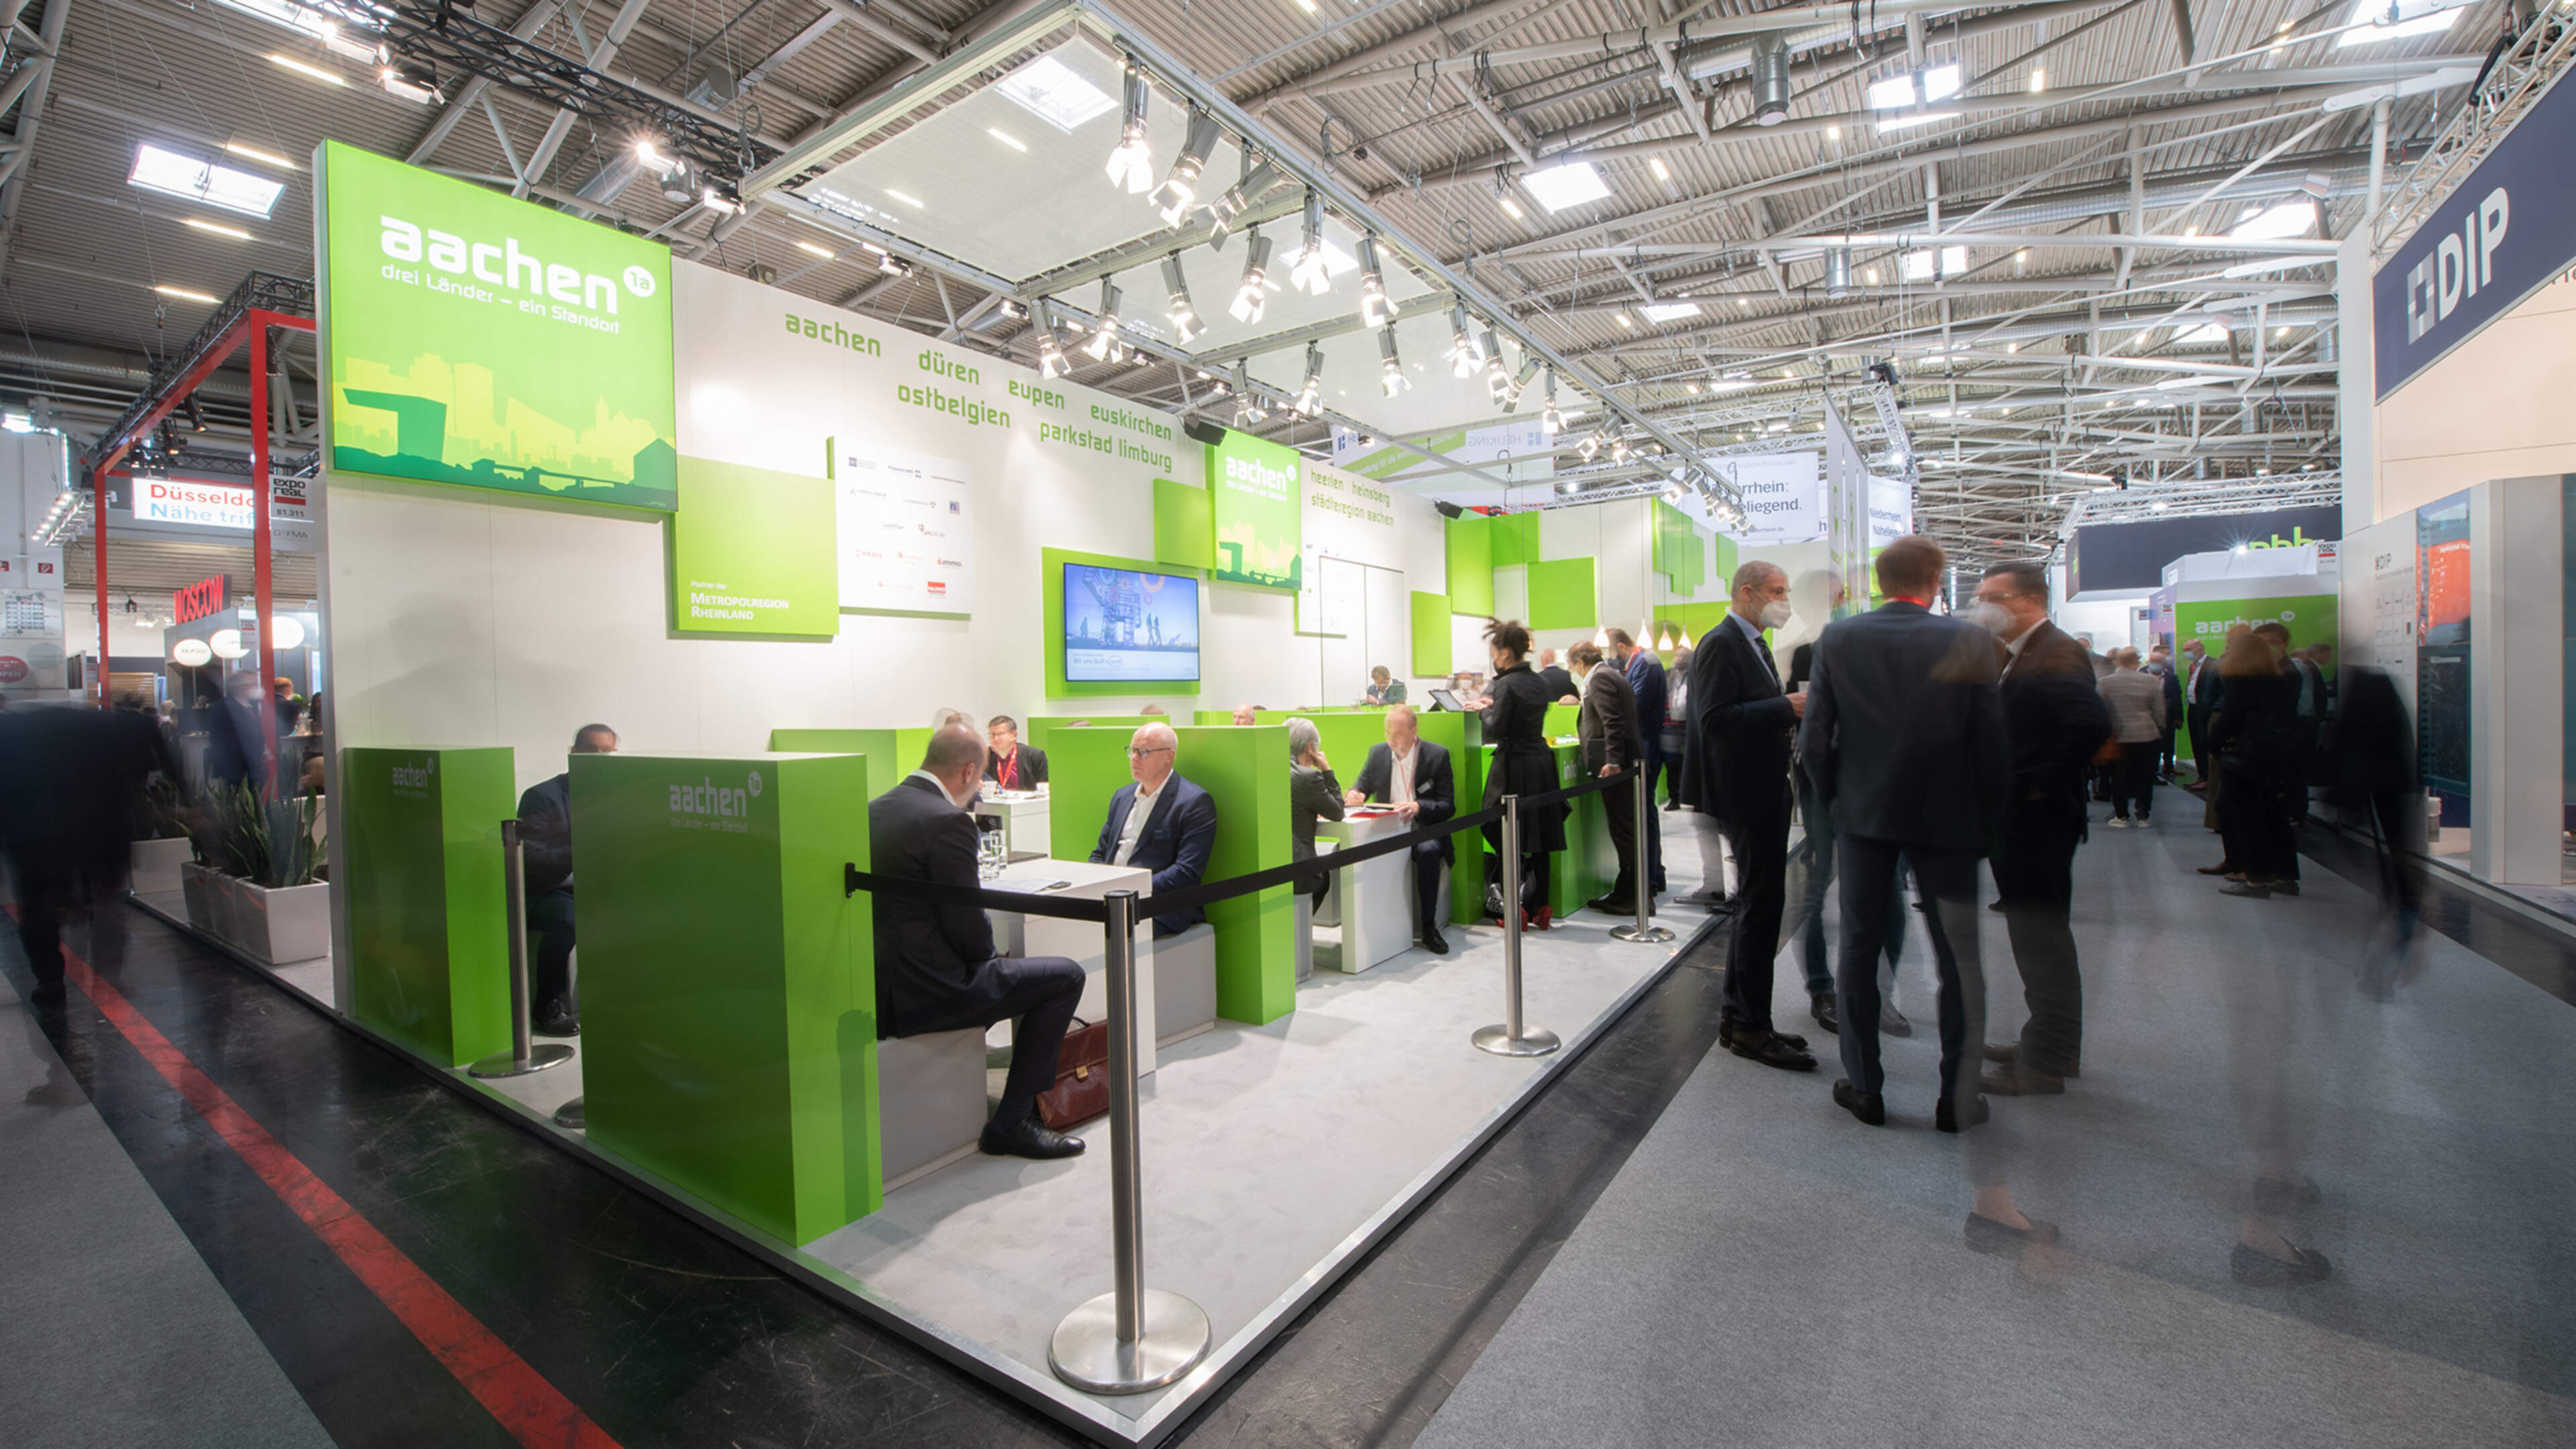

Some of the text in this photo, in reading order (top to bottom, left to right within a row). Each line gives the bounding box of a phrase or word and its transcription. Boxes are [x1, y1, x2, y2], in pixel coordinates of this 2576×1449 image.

[381, 215, 618, 315] aachen
[2437, 186, 2510, 321] DIP
[381, 264, 419, 286] drei
[427, 273, 493, 304] Länder
[519, 299, 546, 317] ein
[551, 305, 619, 335] Standort
[785, 313, 1172, 441] aachen düren eupen euskirchen
[898, 384, 1172, 474] ostbelgien parkstad limburg
[273, 478, 306, 490] expo
[273, 486, 306, 497] real
[1226, 456, 1287, 492] aachen
[1310, 468, 1344, 491] heerlen
[1352, 481, 1391, 508] heinsberg
[150, 503, 254, 525] Nähe trif
[1311, 492, 1395, 527] städteregion aachen
[1743, 498, 1803, 515] eliegend.
[173, 574, 224, 625] MOSCOW
[690, 580, 715, 589] Partner
[392, 759, 428, 789] aachen
[669, 776, 747, 818] aachen
